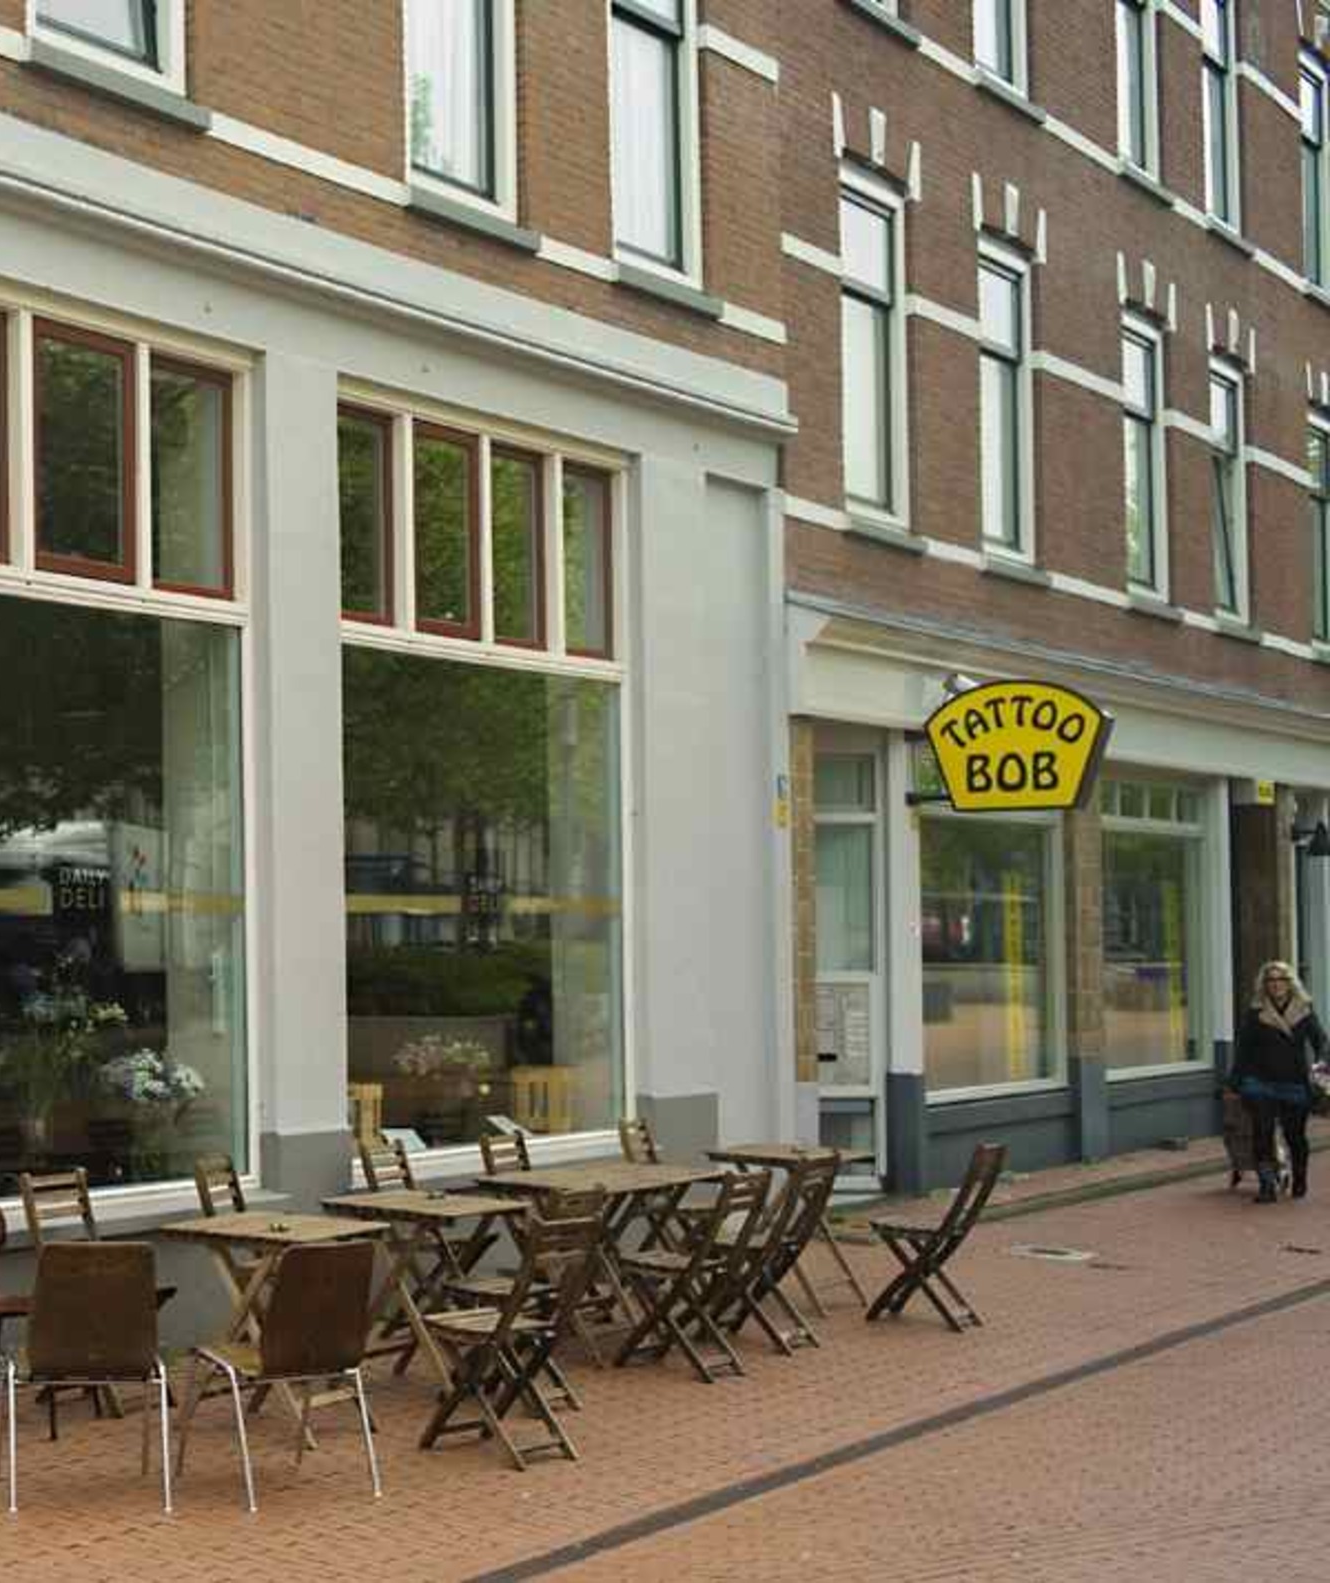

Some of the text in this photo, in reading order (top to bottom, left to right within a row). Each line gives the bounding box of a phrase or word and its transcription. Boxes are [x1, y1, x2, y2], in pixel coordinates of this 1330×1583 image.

[940, 696, 1085, 747] TATTOO
[967, 752, 1059, 793] BOB
[59, 867, 108, 887] DAILY
[61, 888, 106, 909] DELI
